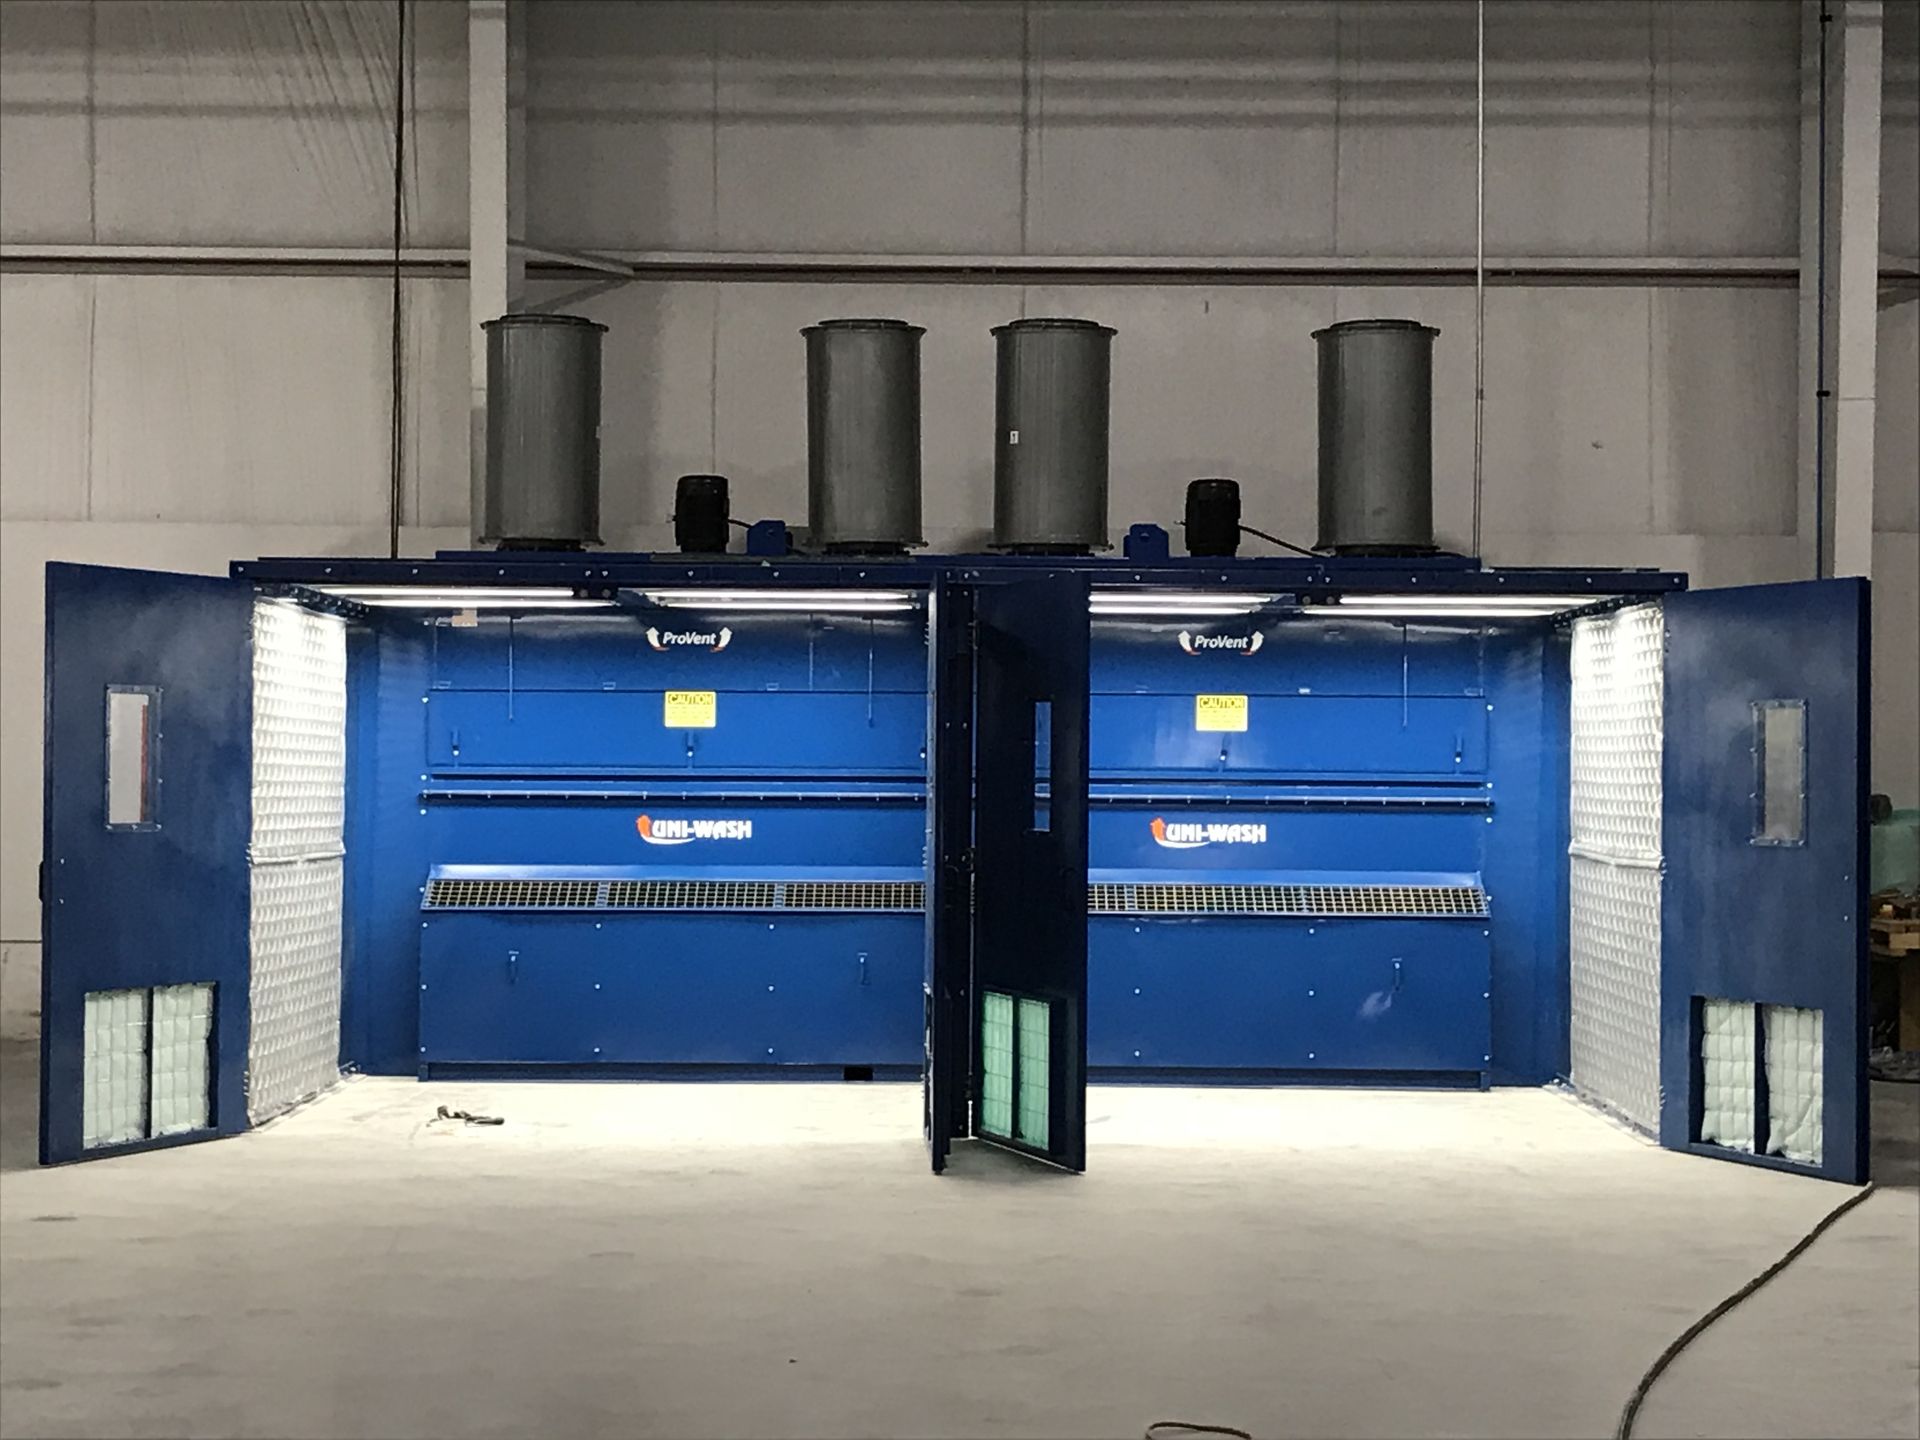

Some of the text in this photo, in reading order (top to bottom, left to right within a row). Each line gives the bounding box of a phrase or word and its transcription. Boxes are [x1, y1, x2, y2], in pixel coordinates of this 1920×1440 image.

[662, 631, 717, 645] ProVent
[1194, 635, 1249, 649] ProVent
[652, 820, 753, 840] UNI-WASH
[1166, 823, 1267, 844] UNI-WASH
